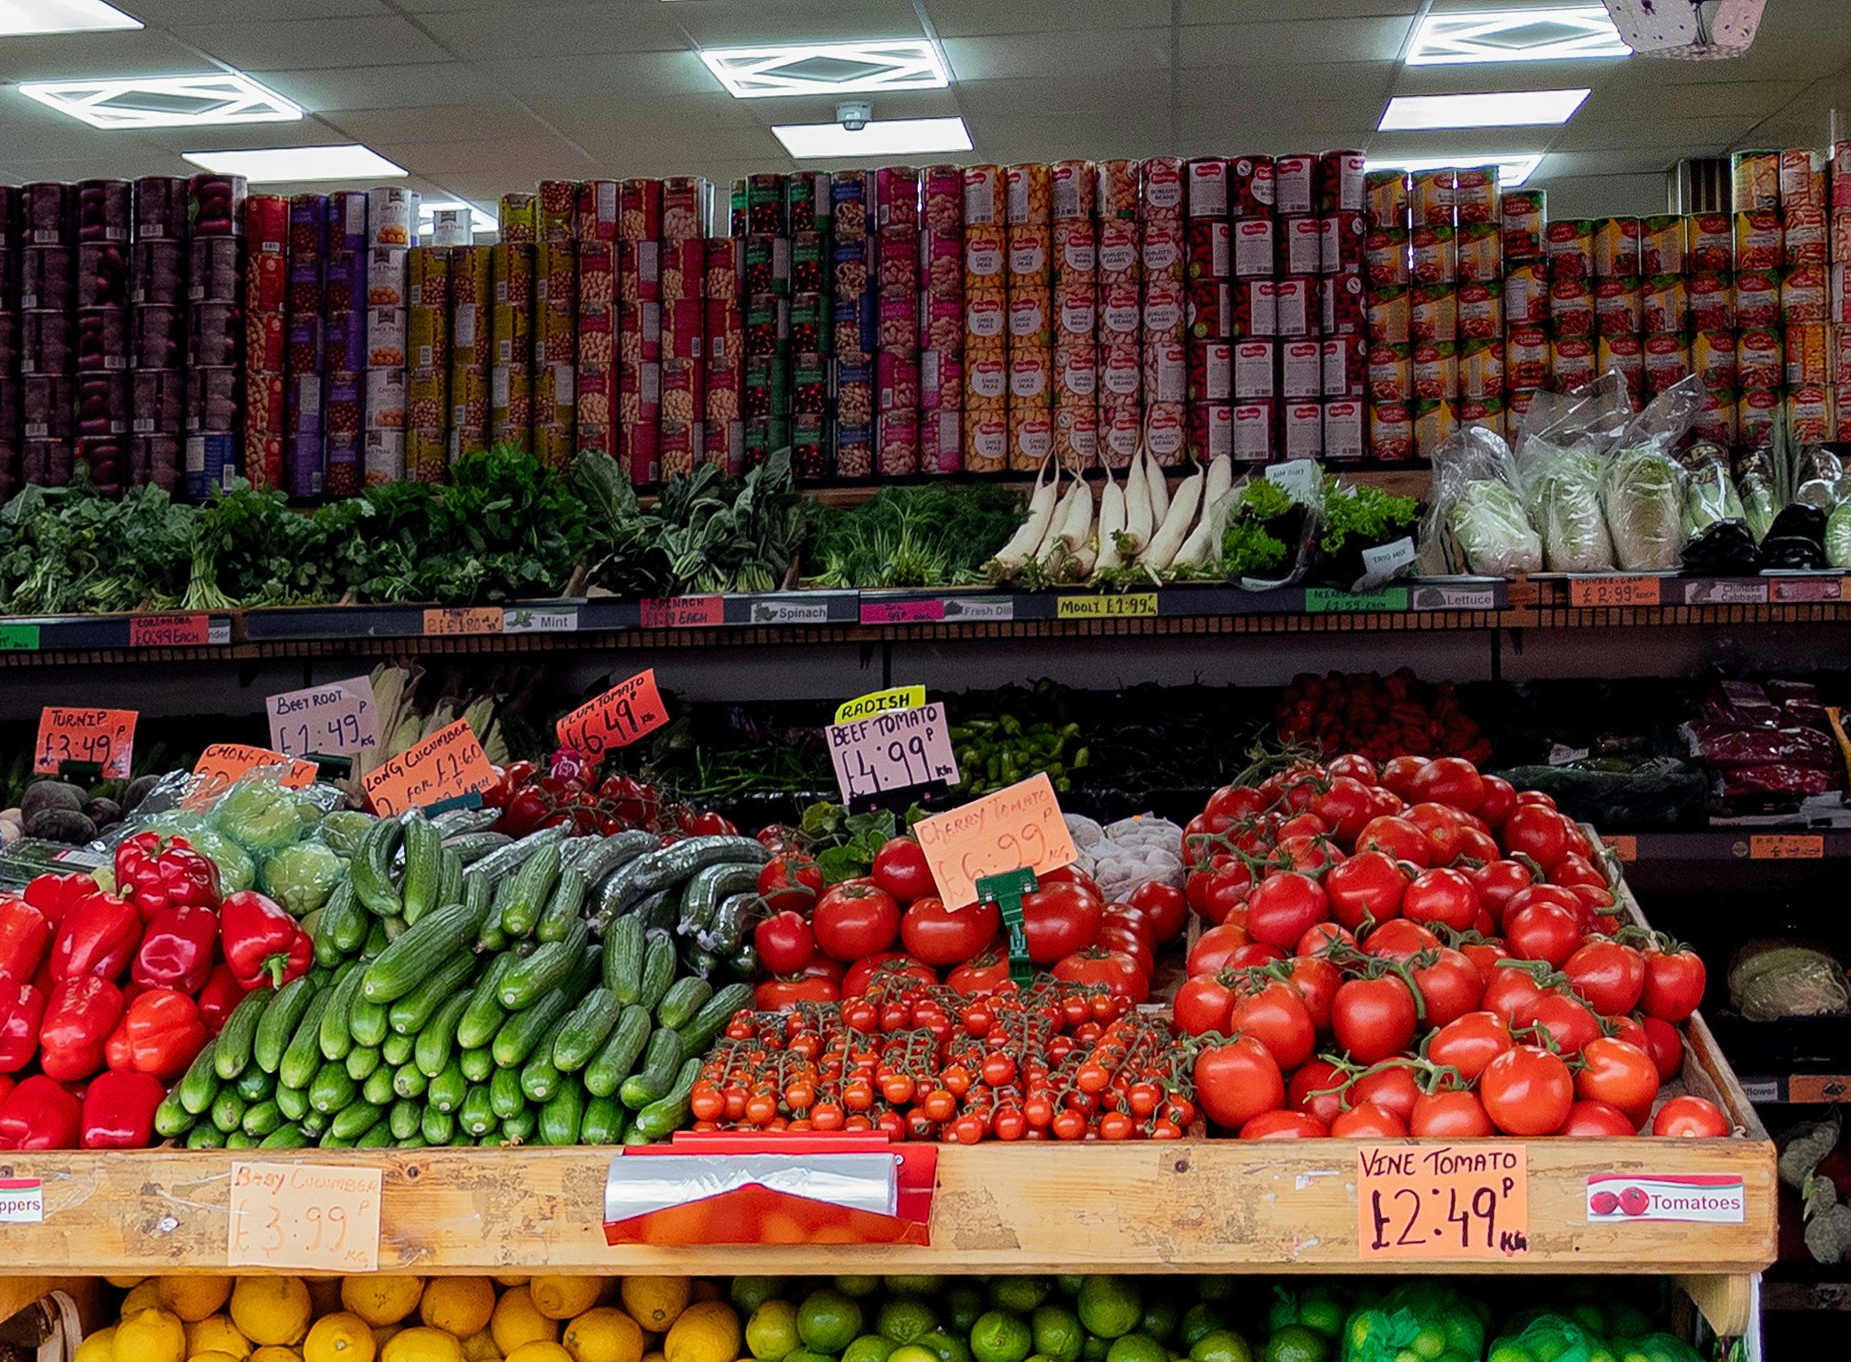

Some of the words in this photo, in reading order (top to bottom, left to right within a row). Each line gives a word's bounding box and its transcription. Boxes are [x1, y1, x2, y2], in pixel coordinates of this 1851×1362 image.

[1446, 594, 1492, 607] Lettuce
[540, 616, 568, 628] Mint
[779, 606, 827, 622] Spinach
[561, 703, 595, 728] PLUM
[596, 675, 645, 708] TOMATO
[841, 693, 910, 720] RADISH
[51, 709, 107, 727] TURNIP
[831, 720, 868, 747] BEEF
[872, 706, 938, 737] TOMATO
[366, 762, 405, 793] LONG
[404, 722, 470, 768] CUCUMBER
[1359, 1148, 1416, 1178] VINE
[1422, 1147, 1517, 1176] TOMATO
[1650, 1194, 1741, 1212] Tomatoes
